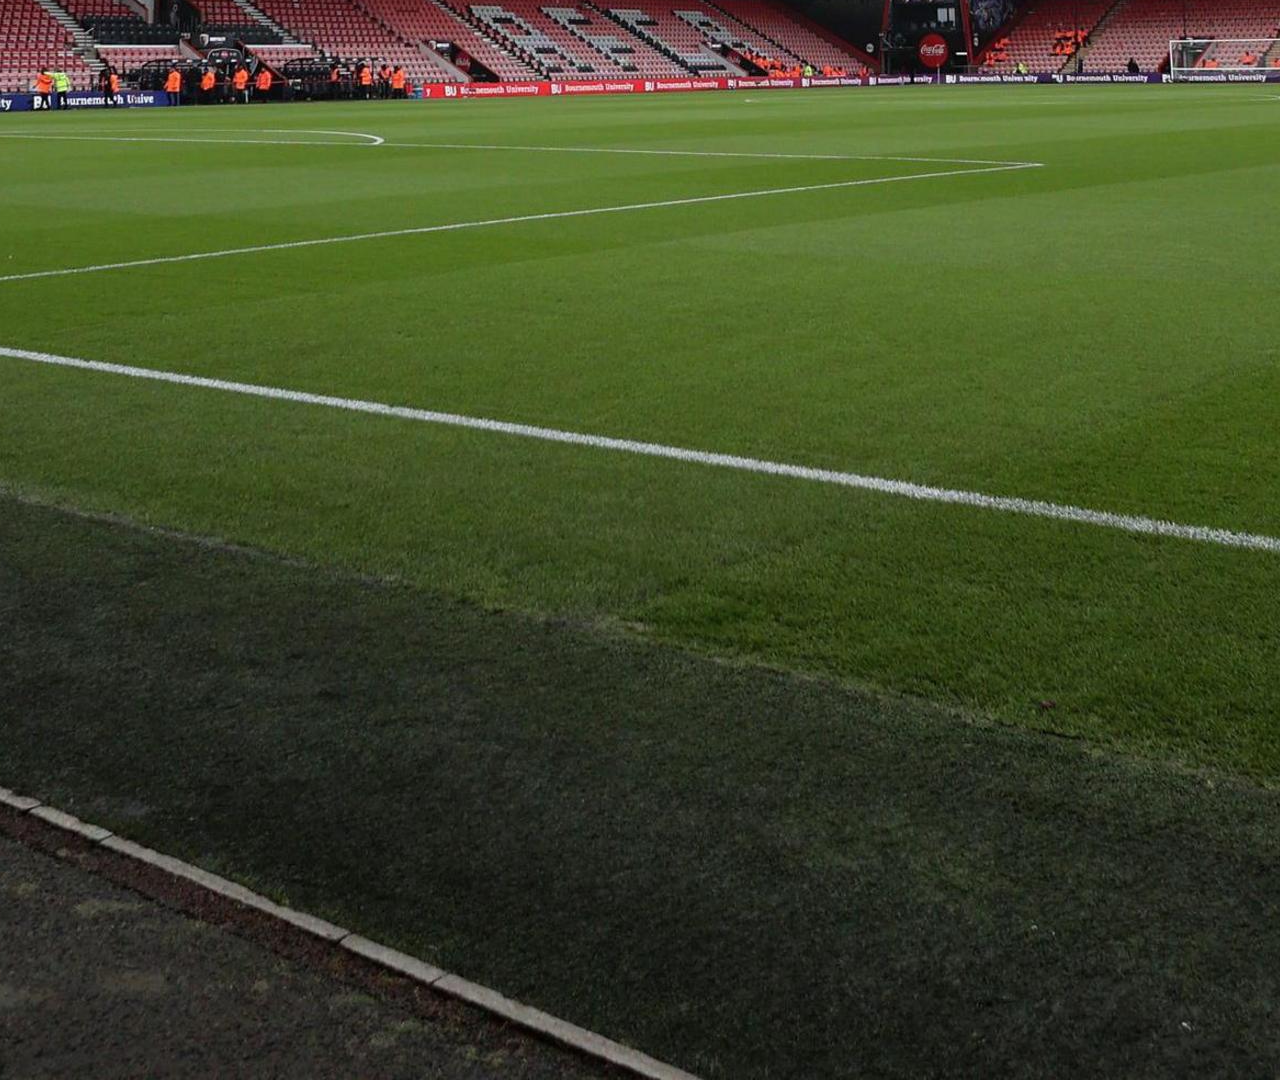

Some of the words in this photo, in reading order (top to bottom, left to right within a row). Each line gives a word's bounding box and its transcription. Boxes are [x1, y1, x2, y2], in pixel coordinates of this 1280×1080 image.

[946, 74, 956, 84] BU
[1113, 73, 1148, 83] University
[445, 86, 457, 97] BU
[507, 85, 539, 95] University
[551, 83, 562, 94] BU
[565, 83, 604, 93] Bournemouth
[606, 81, 634, 92] University
[645, 81, 655, 92] BU
[657, 81, 691, 90] Bournemouth
[693, 80, 718, 90] University
